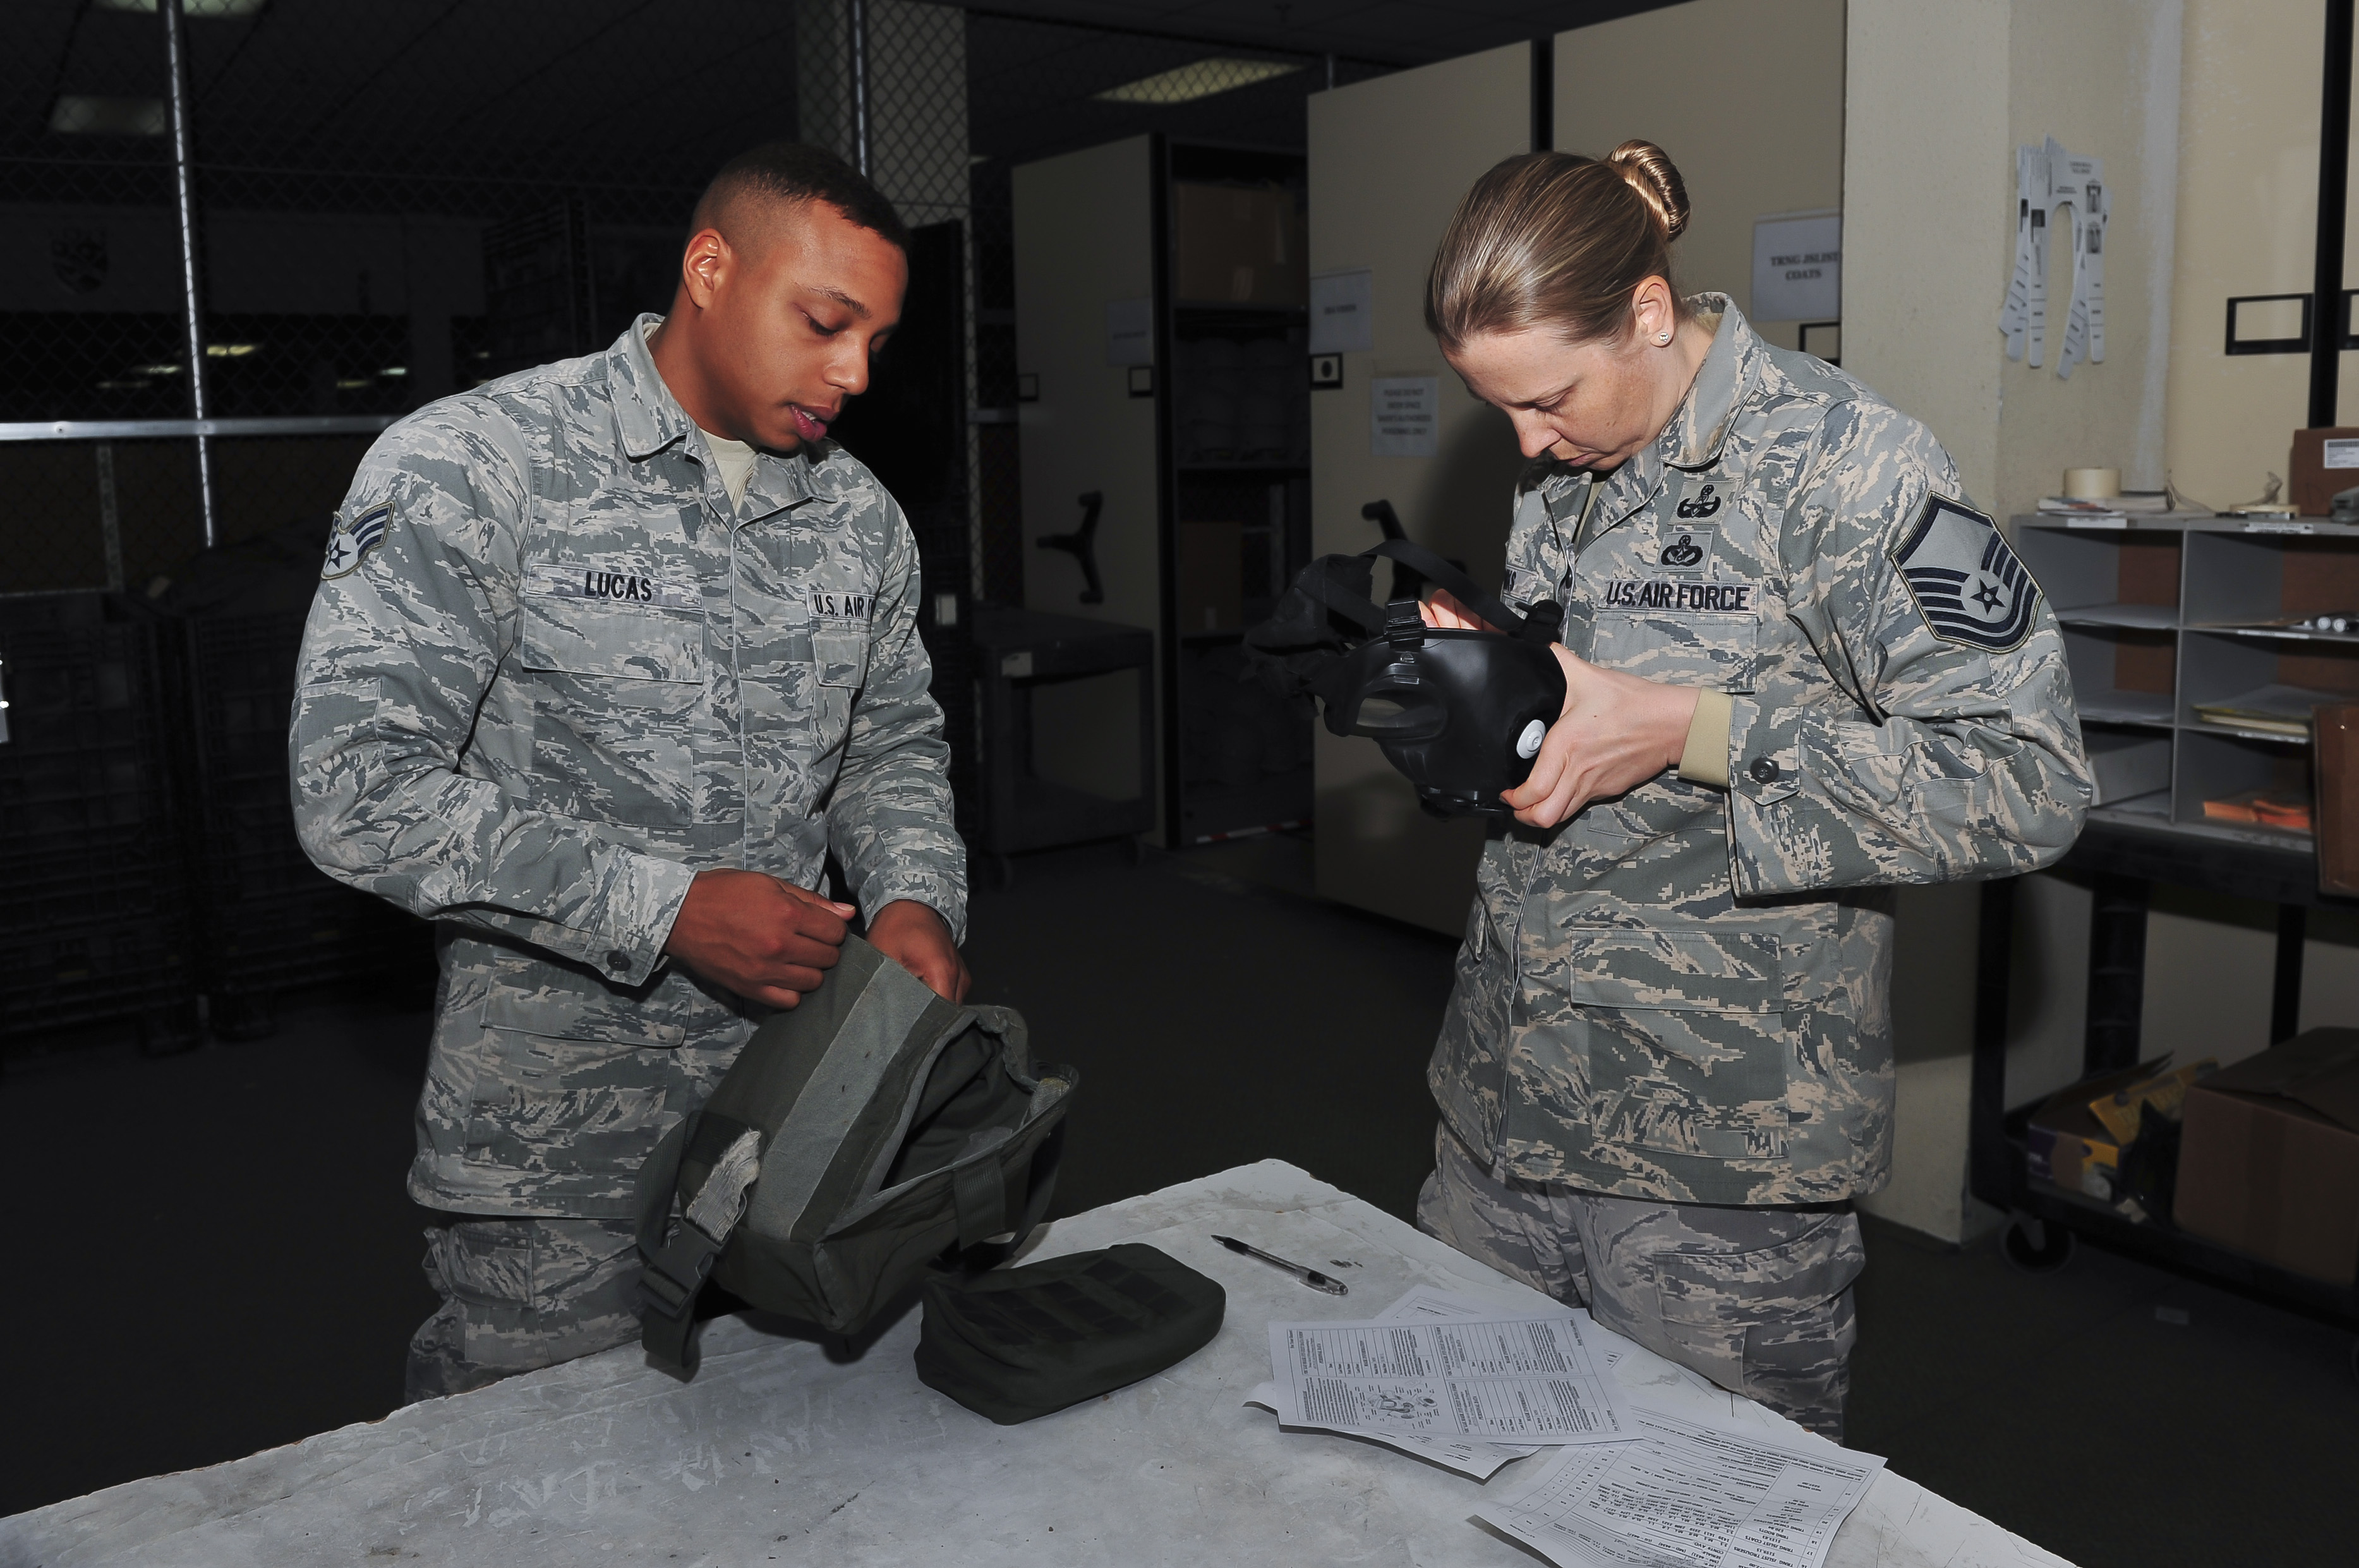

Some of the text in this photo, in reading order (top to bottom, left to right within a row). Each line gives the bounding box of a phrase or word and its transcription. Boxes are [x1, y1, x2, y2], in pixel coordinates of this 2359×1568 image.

[1785, 268, 1822, 280] COATS
[584, 571, 653, 602] LUCAS
[1606, 581, 1750, 611] U.S. AIR FORCE
[814, 594, 838, 617] U.S.
[844, 596, 864, 618] AIR
